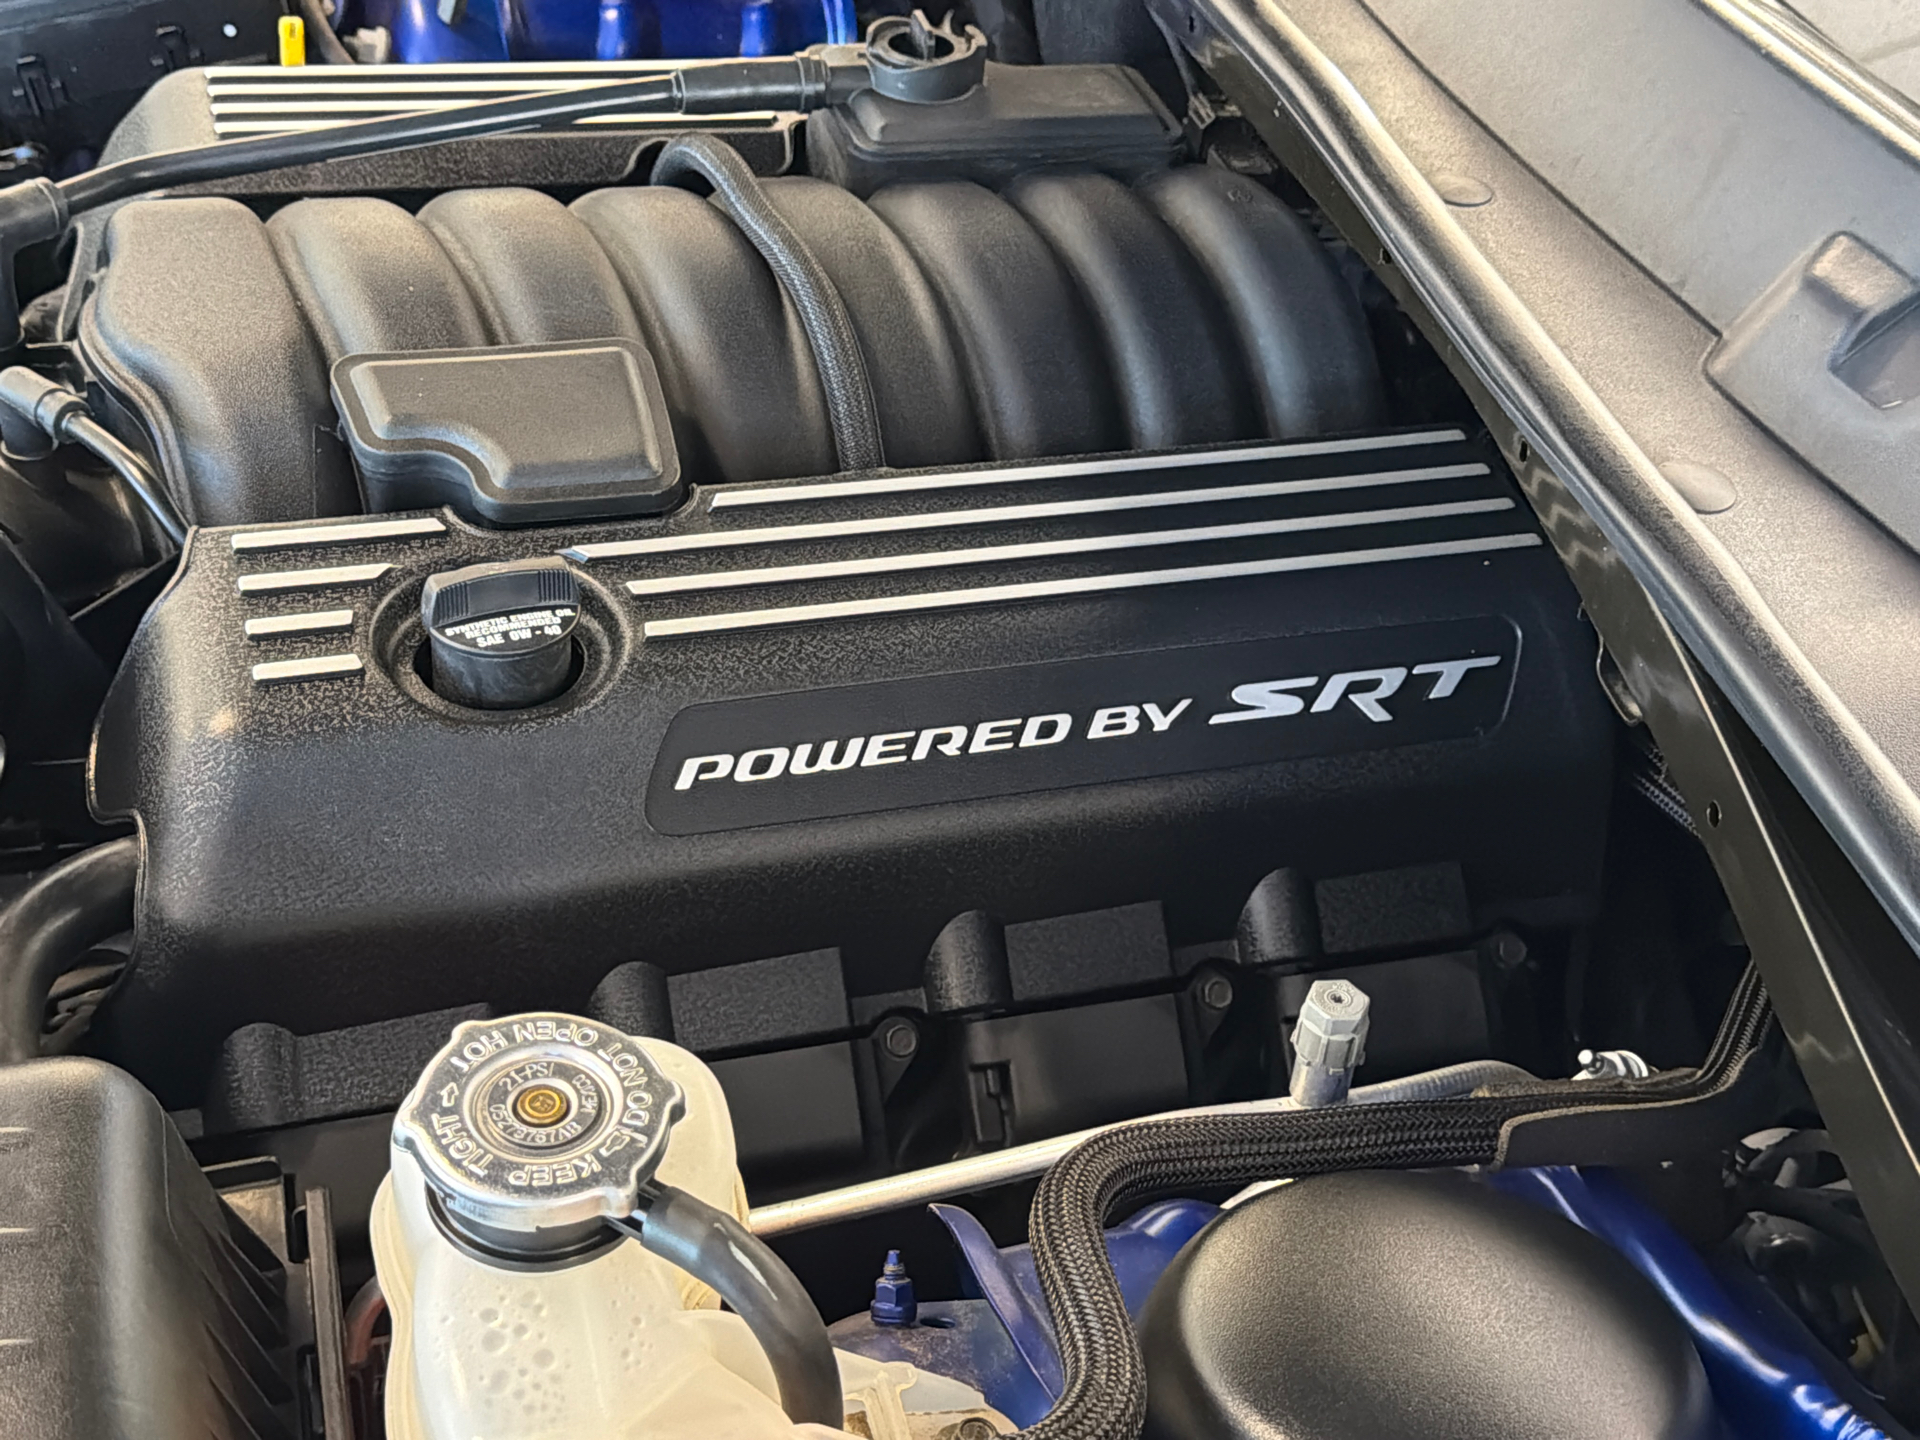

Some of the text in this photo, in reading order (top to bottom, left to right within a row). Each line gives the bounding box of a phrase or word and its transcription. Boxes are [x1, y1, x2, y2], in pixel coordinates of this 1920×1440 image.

[444, 608, 576, 637] SYNTHETIC ENGINE OIL
[464, 616, 562, 639] RECOMMENDED
[476, 633, 505, 647] SAE
[509, 628, 532, 641] 0W
[544, 625, 562, 636] 40
[674, 655, 1501, 791] POWERED BY SRT
[450, 1021, 653, 1126] DO NOT OPEN HOT
[431, 1113, 602, 1187] KEEP TIGHT
